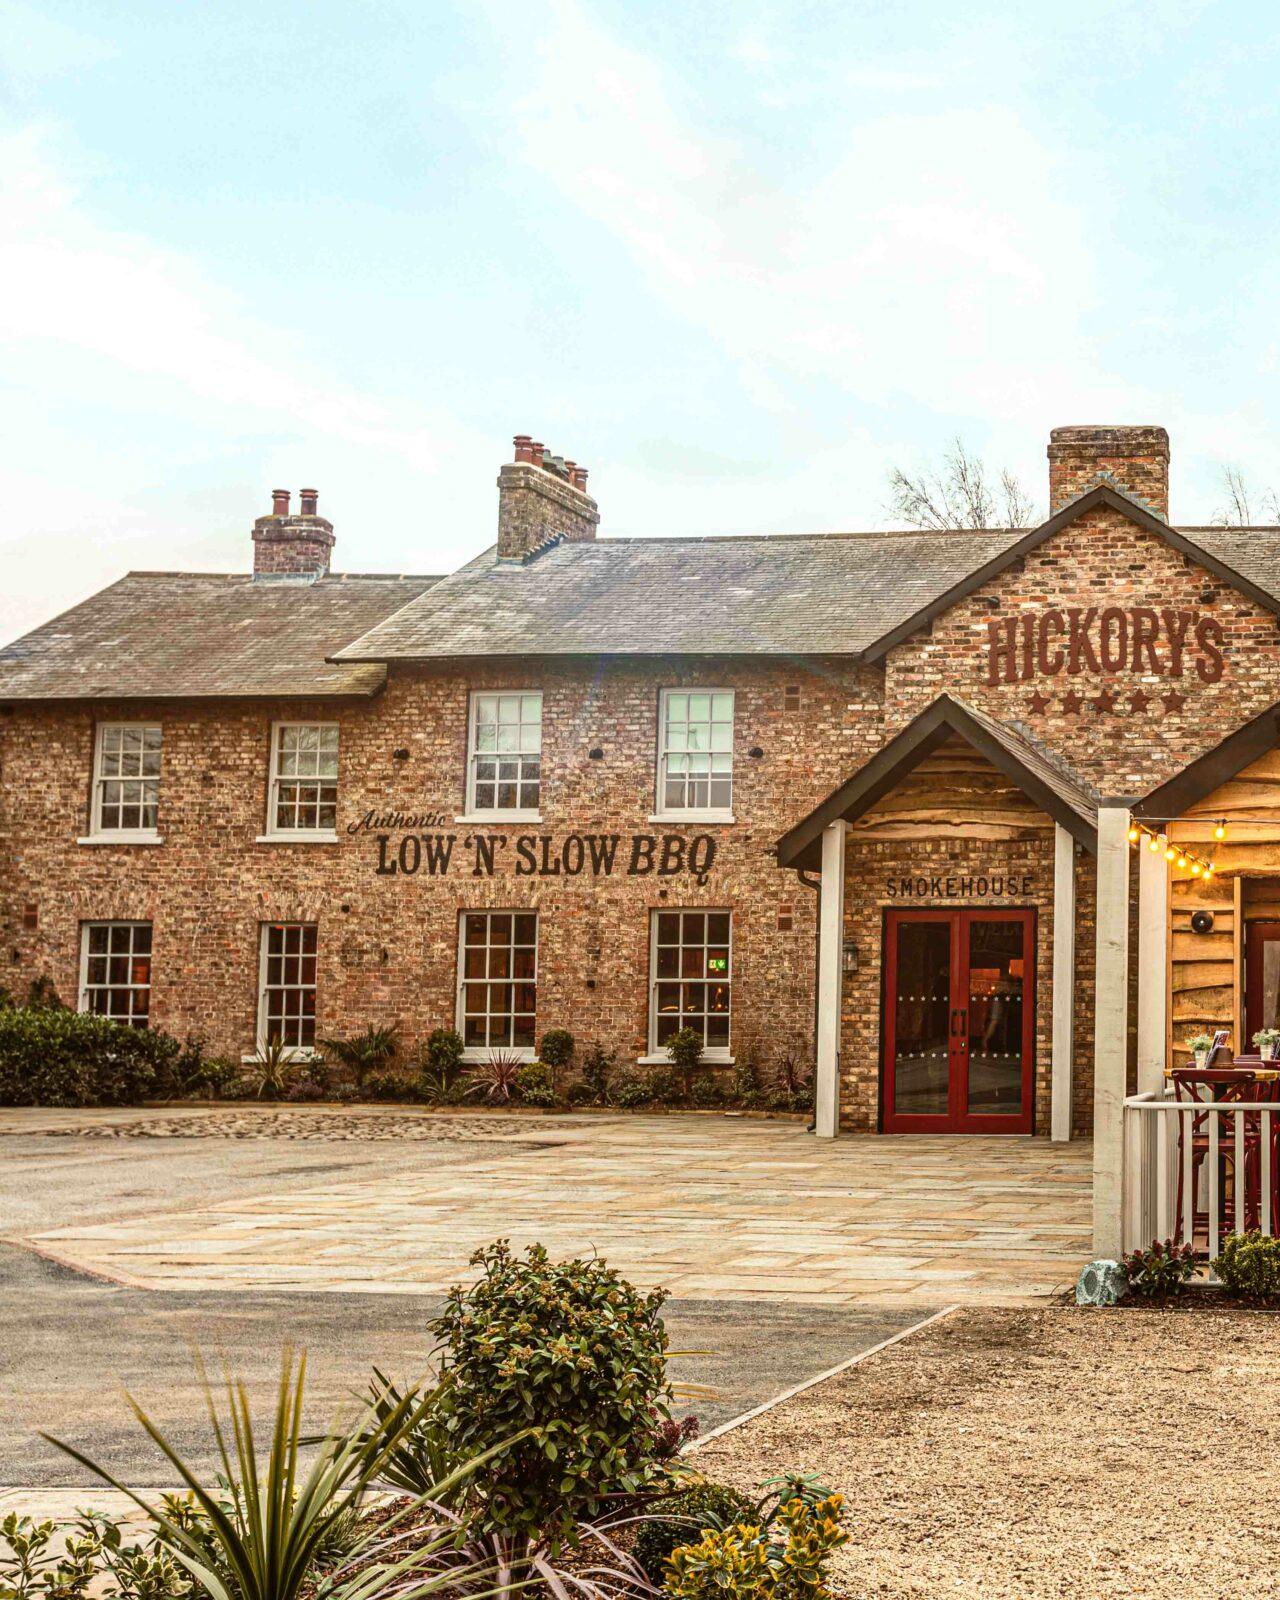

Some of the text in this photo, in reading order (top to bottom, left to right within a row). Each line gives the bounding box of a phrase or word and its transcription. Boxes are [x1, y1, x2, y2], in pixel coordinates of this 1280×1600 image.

[987, 607, 1227, 687] HICKORY'S
[346, 808, 446, 834] Authentic
[375, 834, 455, 876] LOW
[516, 834, 622, 876] SLOW
[627, 833, 718, 887] BBQ
[886, 876, 1035, 897] SMOKEHOUSE
